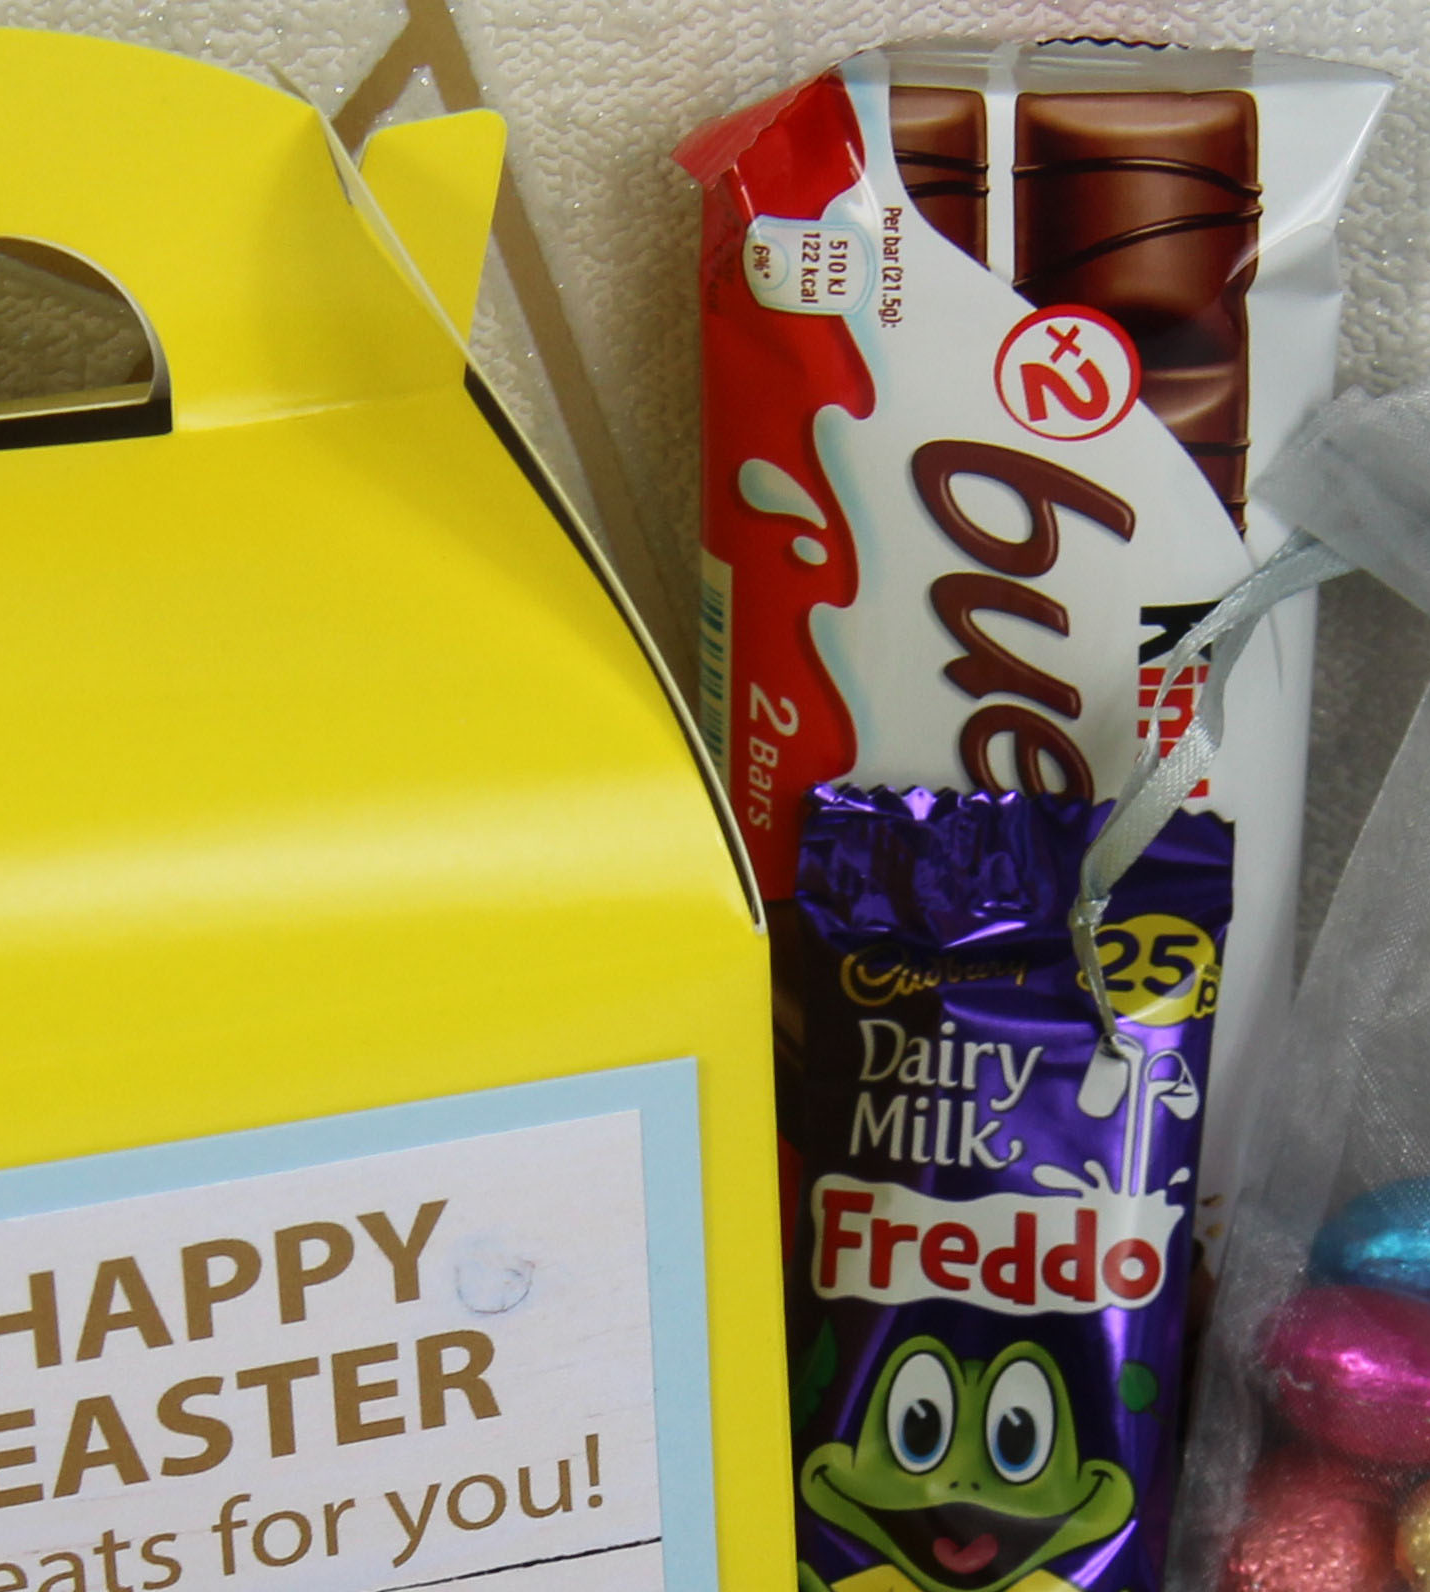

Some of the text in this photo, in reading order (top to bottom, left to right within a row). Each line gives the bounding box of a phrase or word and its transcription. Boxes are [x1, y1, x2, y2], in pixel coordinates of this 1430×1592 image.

[800, 232, 821, 304] 122 kcal
[827, 239, 848, 274] 510
[878, 206, 903, 328] Per bar (21.5g):
[747, 681, 800, 831] 2 Bars
[858, 1018, 1044, 1112] Dairy
[849, 1092, 1023, 1170] Milk
[819, 1188, 1161, 1306] Freddo
[211, 1493, 358, 1577] for
[385, 1433, 605, 1569] you!
